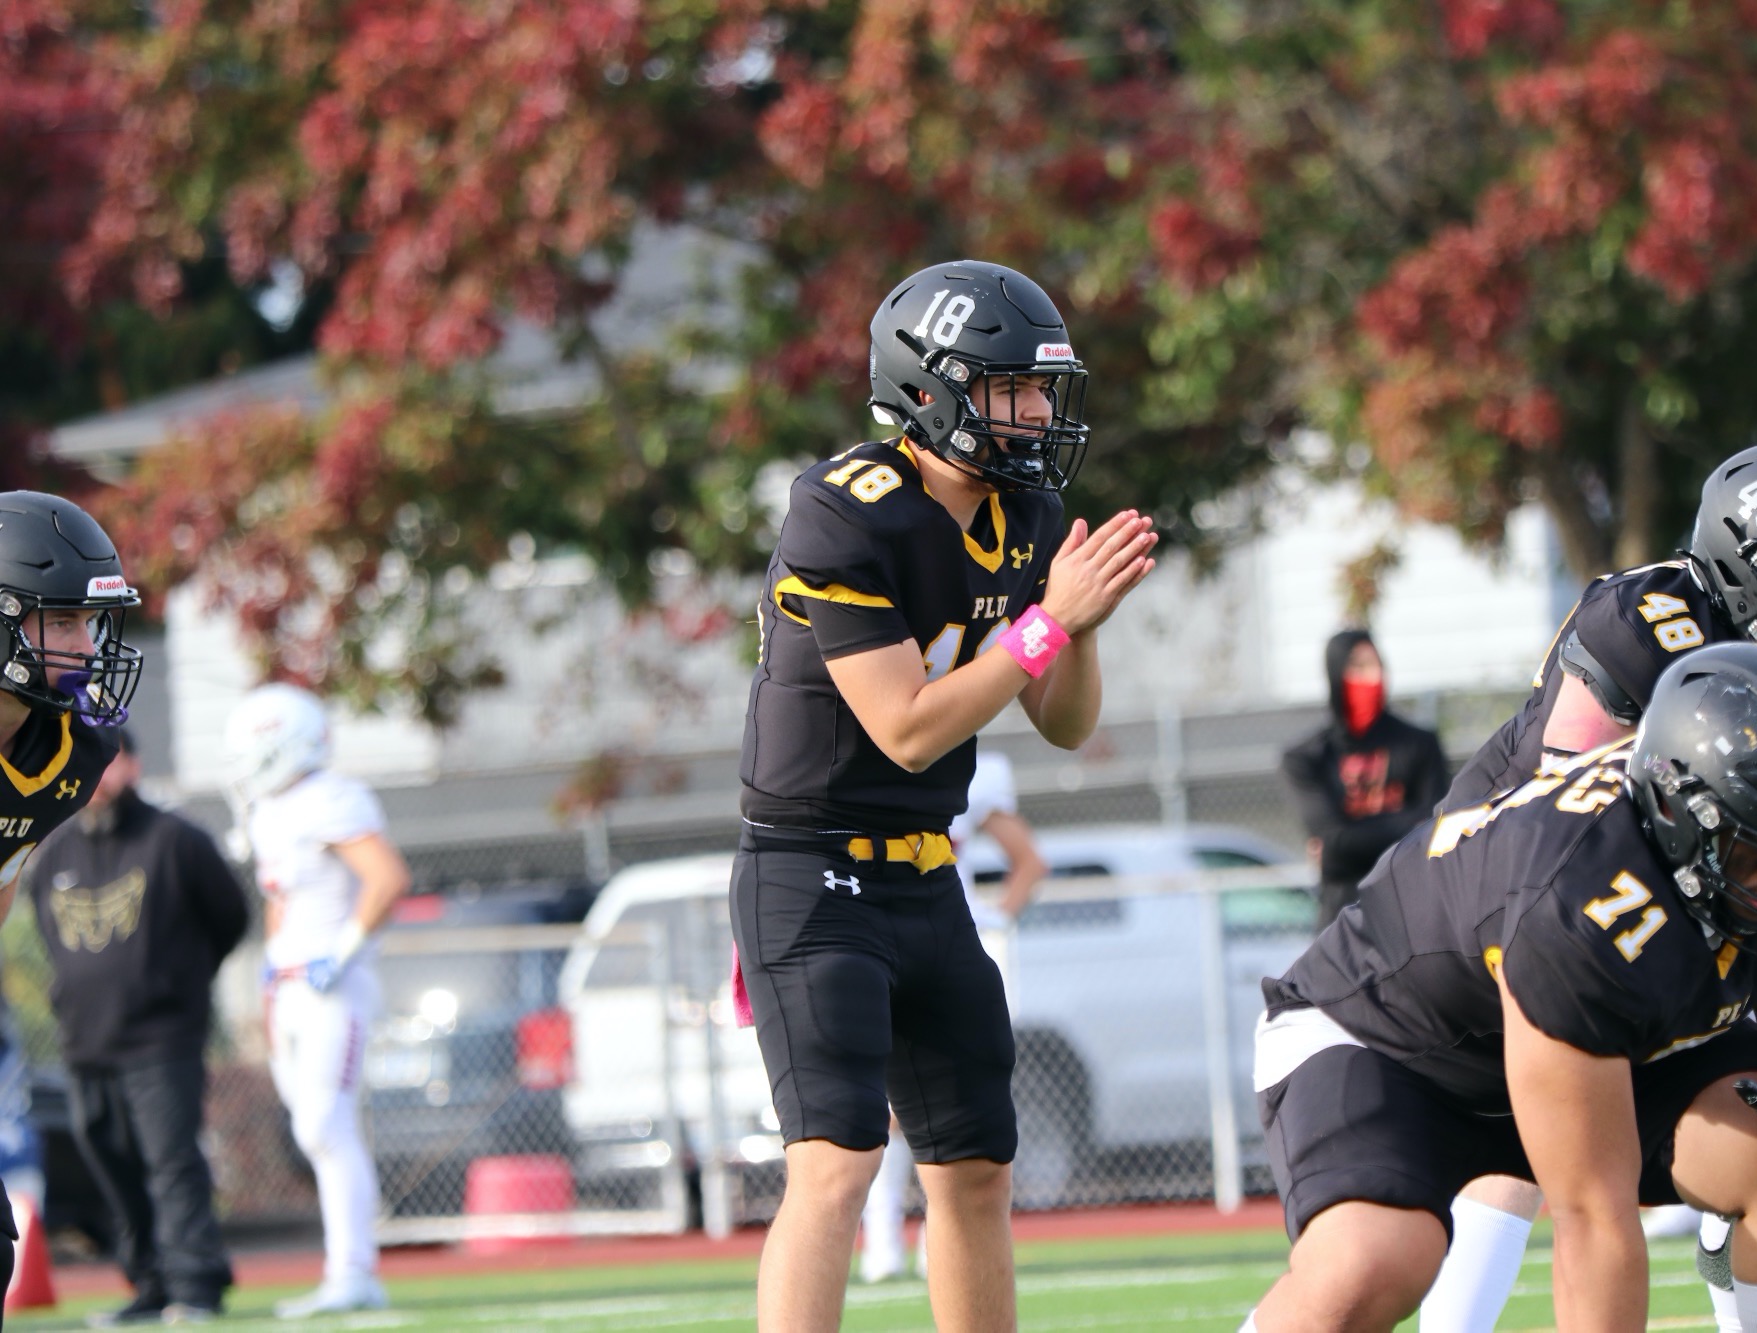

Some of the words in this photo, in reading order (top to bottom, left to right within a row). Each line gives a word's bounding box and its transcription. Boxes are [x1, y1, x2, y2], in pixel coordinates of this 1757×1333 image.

[914, 289, 976, 347] 18
[824, 459, 902, 503] 18
[971, 595, 1009, 619] PLU
[1637, 593, 1705, 653] 48
[1583, 869, 1668, 963] 71
